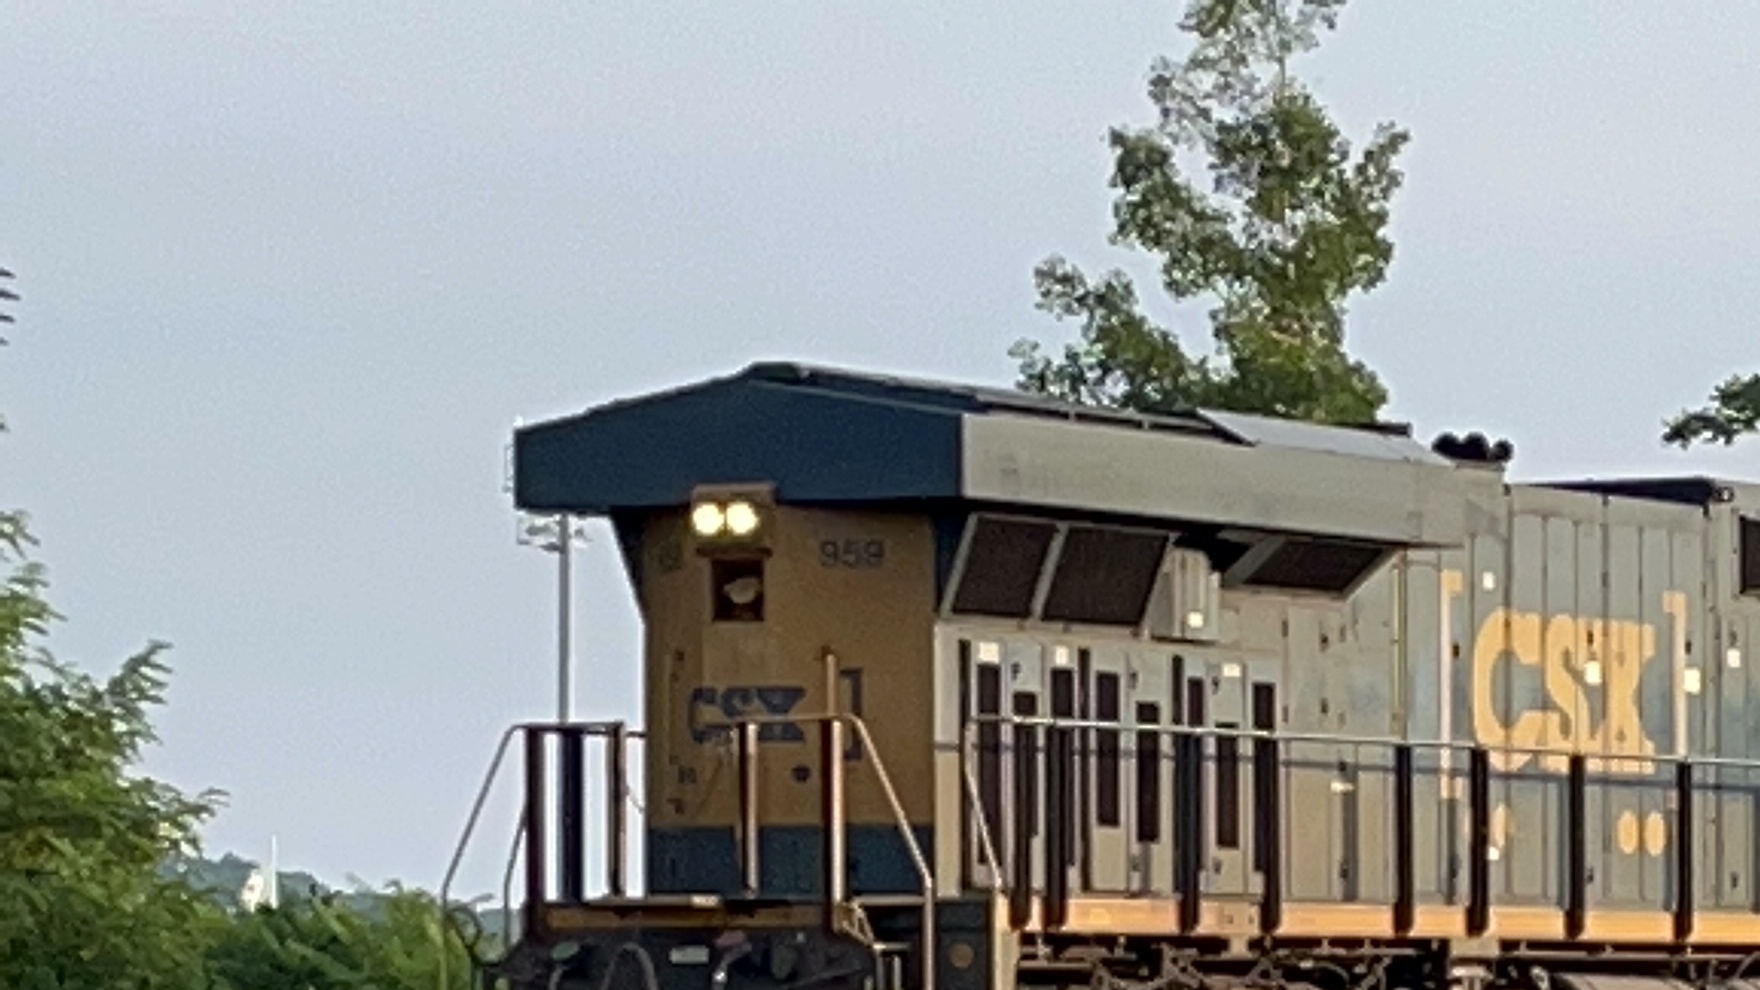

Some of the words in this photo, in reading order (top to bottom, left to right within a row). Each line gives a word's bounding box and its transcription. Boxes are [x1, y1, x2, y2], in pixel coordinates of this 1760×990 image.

[820, 540, 884, 568] 959
[688, 687, 807, 744] CSX
[1472, 606, 1655, 774] CSX
